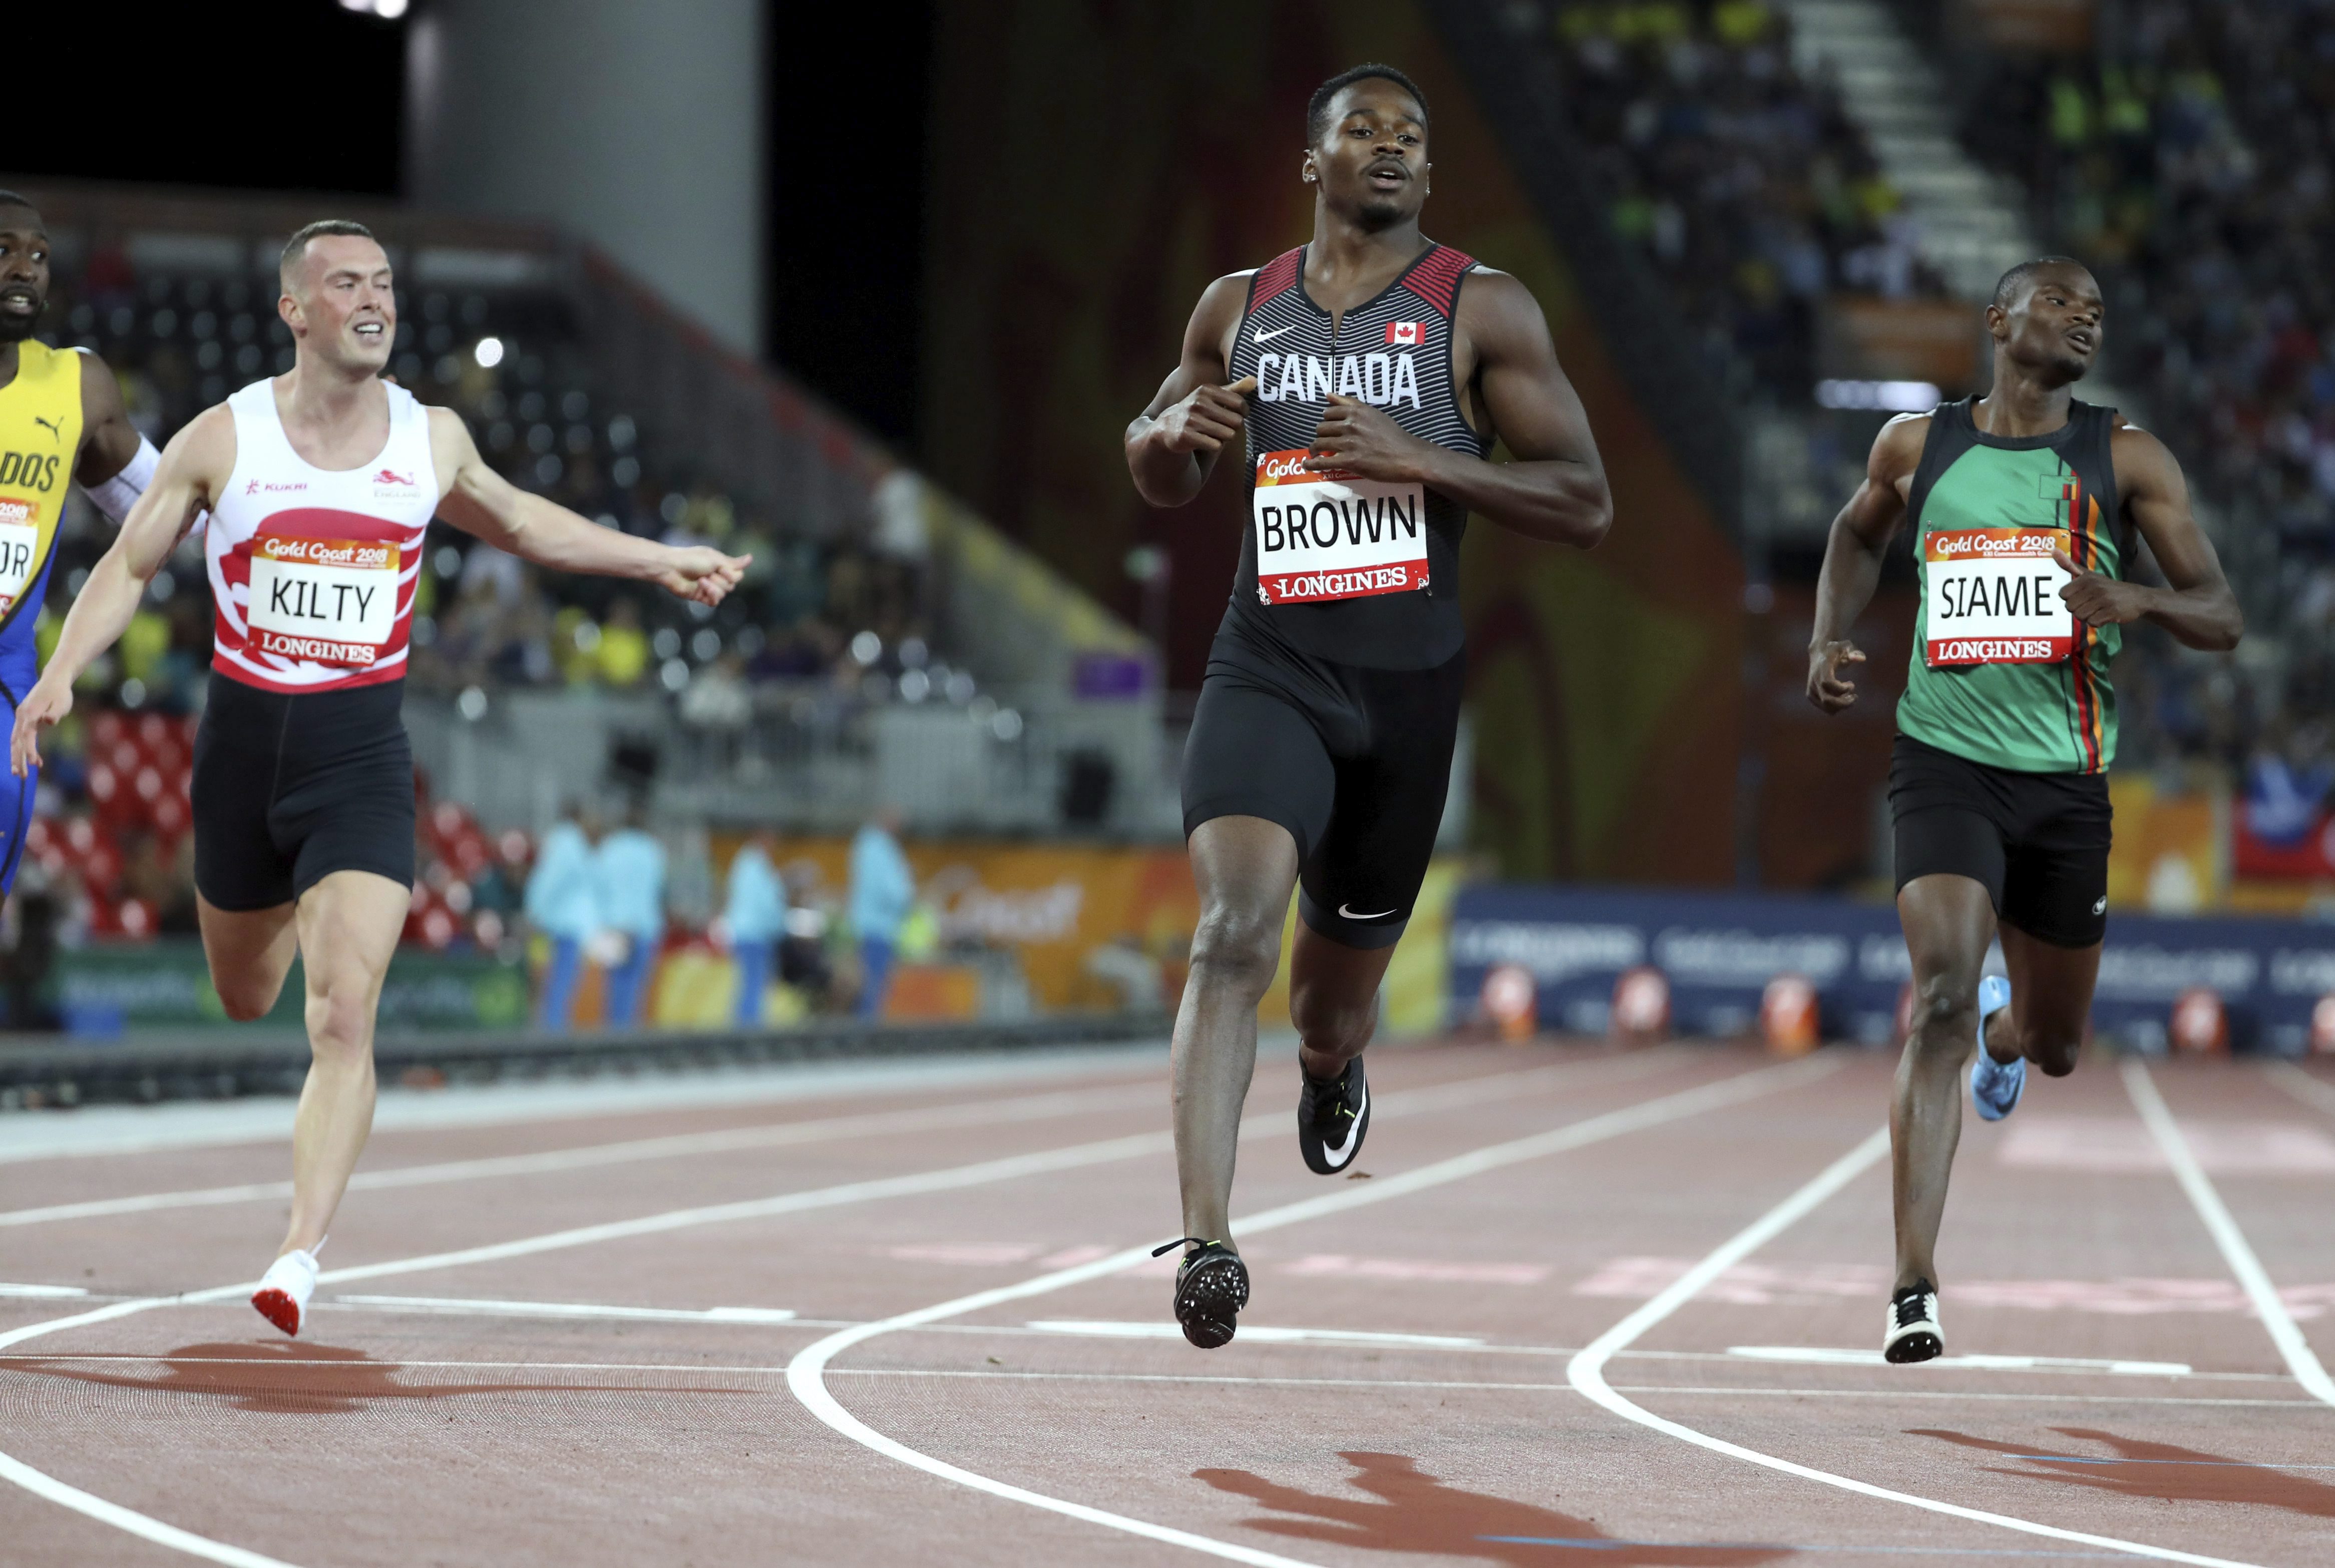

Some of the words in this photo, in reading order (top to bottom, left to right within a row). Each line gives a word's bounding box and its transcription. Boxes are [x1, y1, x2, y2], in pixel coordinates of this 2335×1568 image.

[1257, 353, 1420, 409] CANADA
[0, 452, 59, 492] DOS
[1266, 456, 1306, 479] Gold
[1262, 494, 1416, 552] BROWN
[264, 538, 308, 558] Gold
[309, 543, 354, 561] Coast
[355, 548, 388, 563] 2018
[1936, 535, 1973, 555] Gold
[1974, 534, 2019, 551] Coast
[2021, 536, 2056, 551] 2018
[1278, 567, 1407, 597] LONGINES
[1941, 576, 2053, 618] SIAME
[271, 577, 375, 622] KILTY
[262, 632, 375, 664] LONGINES
[1937, 640, 2052, 660] LONGINES
